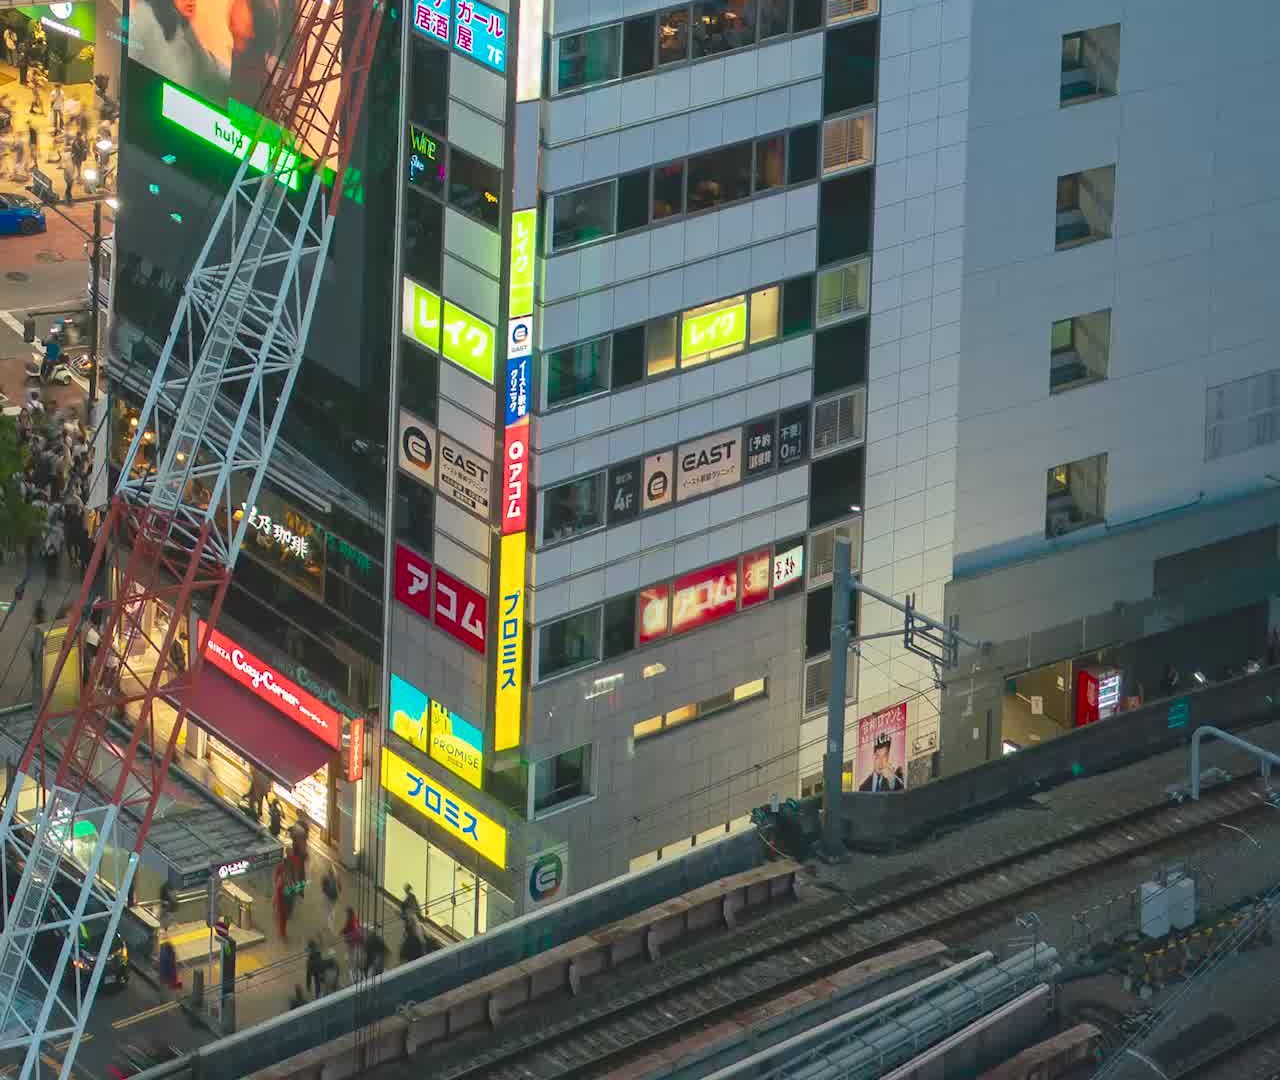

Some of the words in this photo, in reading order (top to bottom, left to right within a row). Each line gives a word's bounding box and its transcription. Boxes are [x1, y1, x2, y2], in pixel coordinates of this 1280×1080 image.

[416, 7, 474, 52] 居酒屋
[486, 43, 503, 65] 7F
[514, 221, 529, 273] レイク
[419, 298, 489, 358] レイク
[691, 311, 737, 346] レイク
[442, 445, 489, 482] EAST
[682, 439, 736, 472] EAST
[506, 461, 524, 519] アコム
[613, 487, 633, 512] 4F
[407, 562, 485, 641] アコム
[675, 571, 738, 618] アコム
[207, 639, 232, 663] GINZA
[501, 589, 521, 690] プロミス
[432, 735, 480, 770] PROMISE
[406, 771, 479, 841] プロミス
